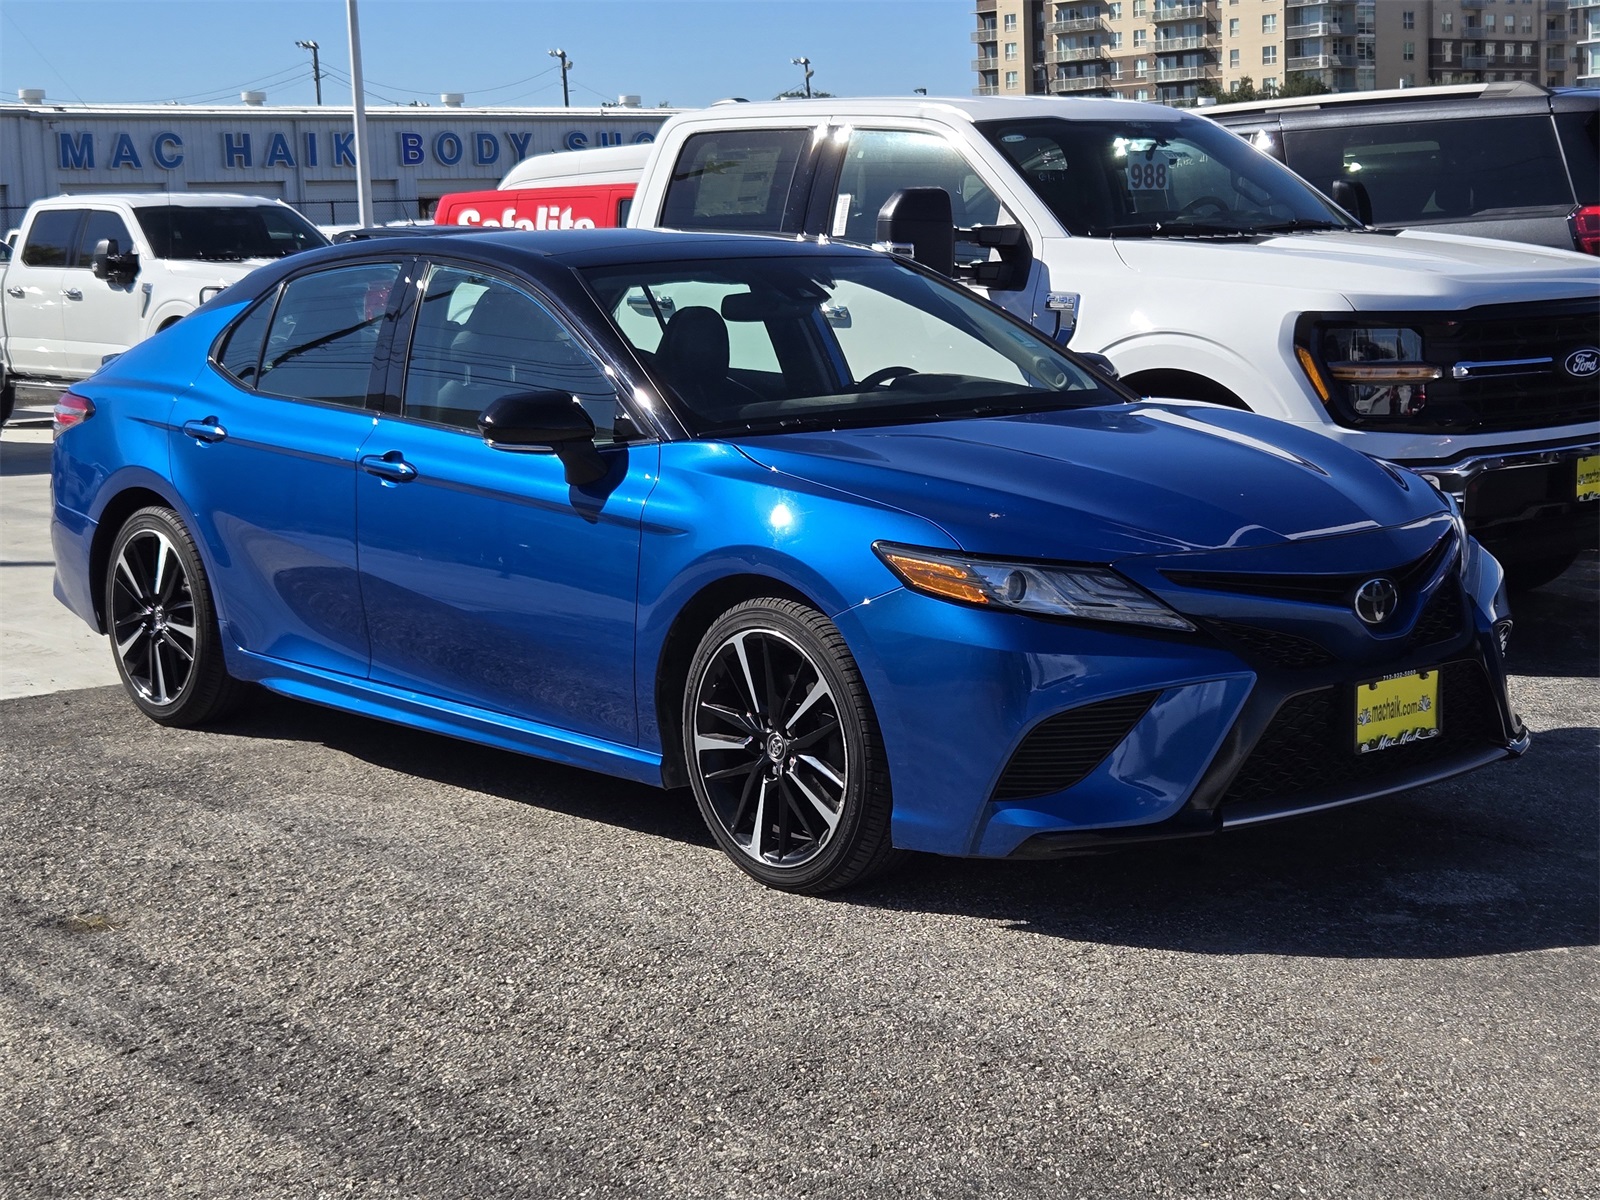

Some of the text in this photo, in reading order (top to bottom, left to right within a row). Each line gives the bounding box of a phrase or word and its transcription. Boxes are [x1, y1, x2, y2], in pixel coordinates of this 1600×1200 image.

[59, 131, 184, 170] MAC
[223, 131, 357, 168] HAIK
[400, 131, 533, 167] BODY
[1131, 163, 1167, 189] 988
[1573, 353, 1598, 372] Ford
[1371, 695, 1418, 722] machaik.com
[1378, 734, 1399, 750] Mac
